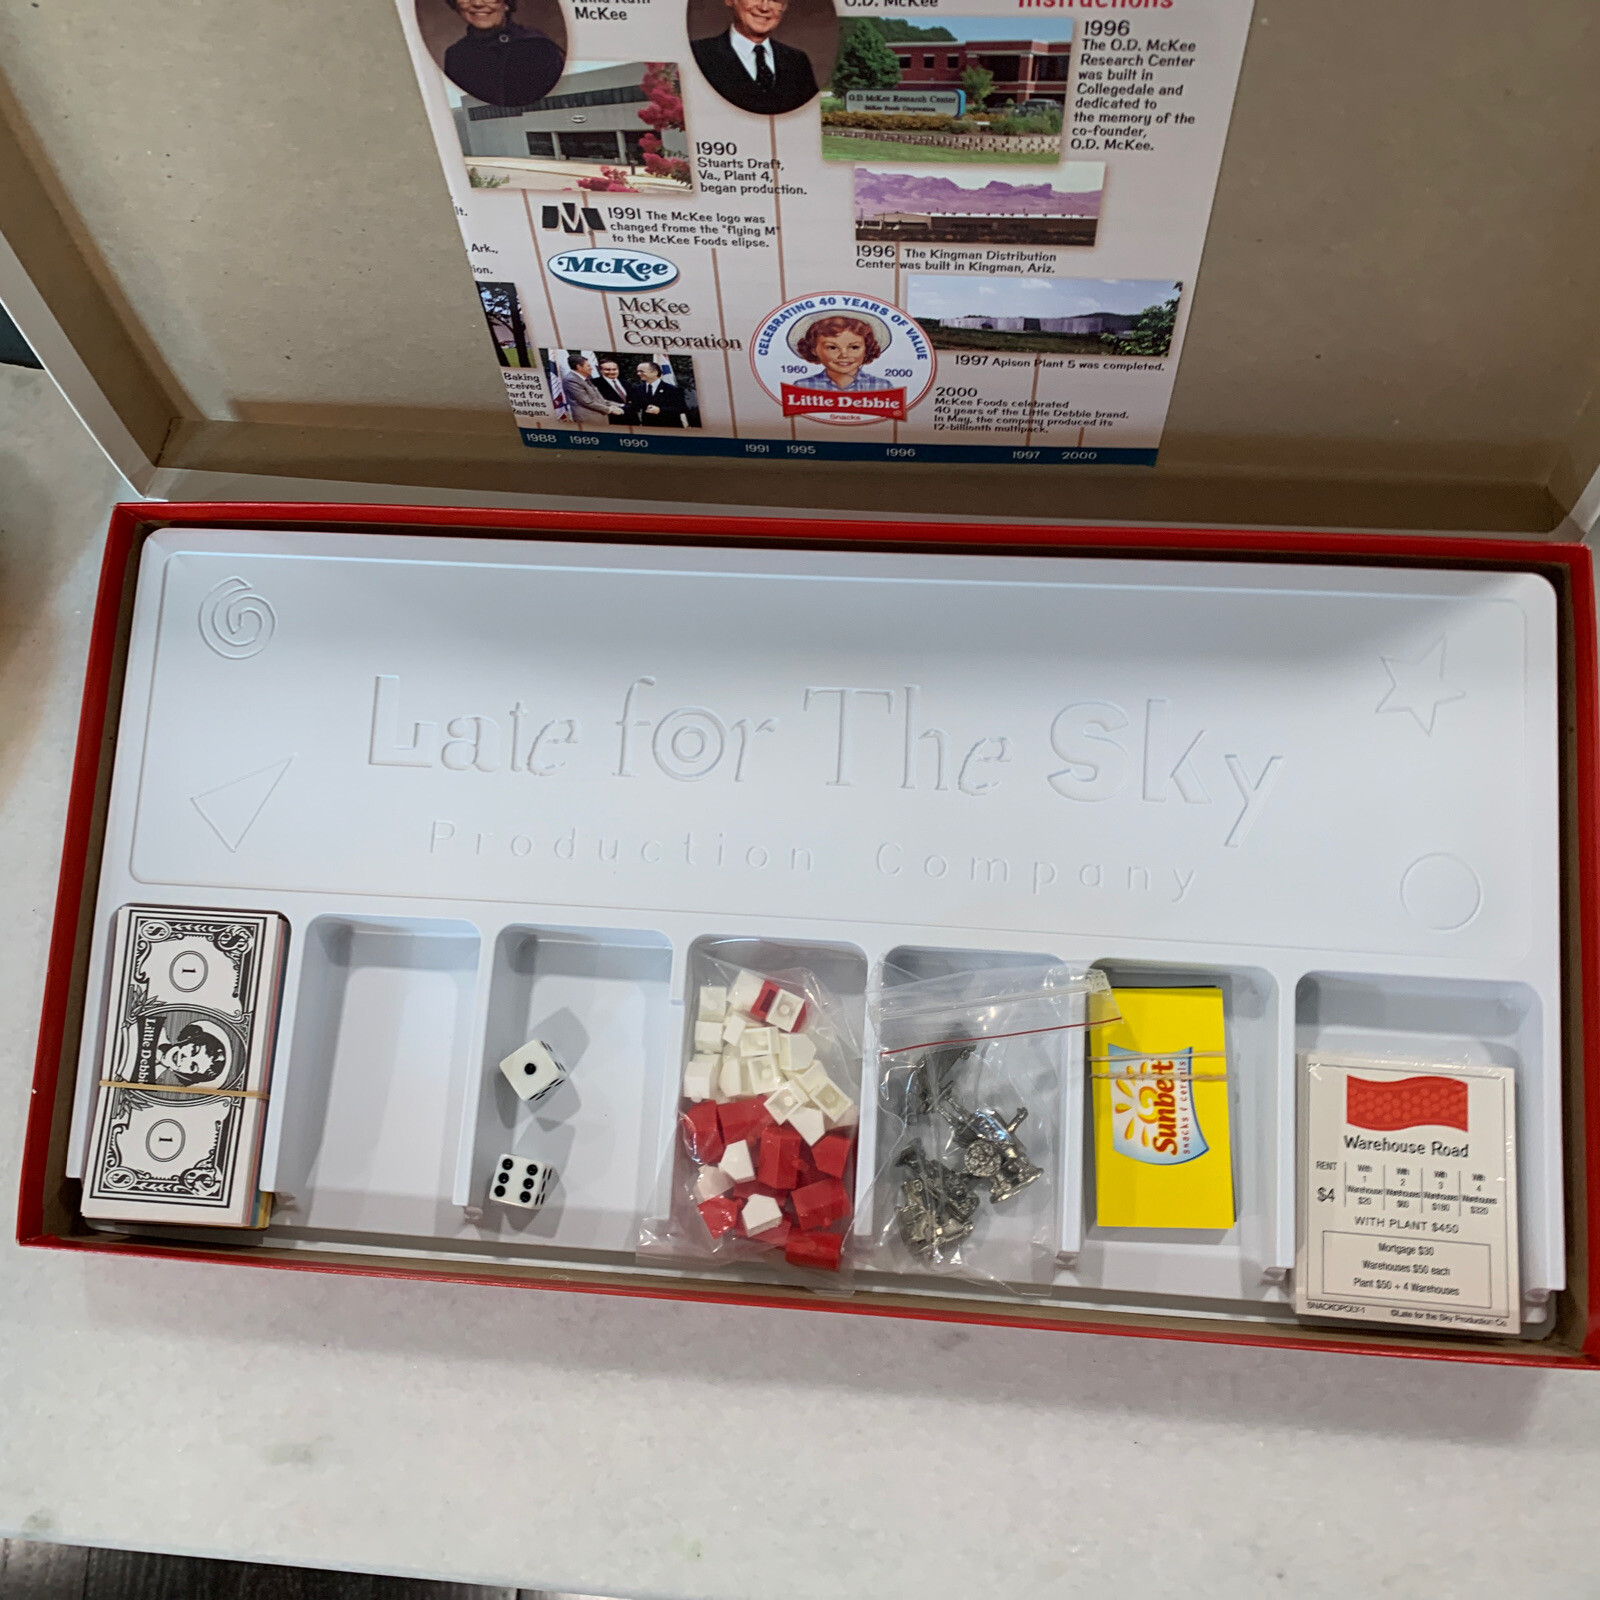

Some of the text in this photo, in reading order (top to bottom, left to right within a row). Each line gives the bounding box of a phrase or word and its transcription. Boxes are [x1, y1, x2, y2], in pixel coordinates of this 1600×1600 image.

[574, 6, 627, 20] McKee
[1084, 20, 1130, 36] 1996
[1082, 38, 1196, 52] The O.D. McKee
[1080, 53, 1196, 67] Research Center
[1078, 68, 1154, 81] was built in
[1077, 82, 1184, 98] Collegedale and
[1075, 97, 1157, 110] dedicated to
[1073, 111, 1195, 126] the memory of the
[1072, 125, 1147, 139] co-founder,
[696, 142, 737, 155] 1990
[1070, 138, 1154, 151] O.D. McKee.
[697, 157, 784, 171] Stuarts Draft,
[724, 170, 756, 181] Plant
[760, 171, 773, 183] 4,
[700, 182, 807, 196] began production.
[607, 206, 765, 224] 1991 The McKee logo was
[610, 222, 658, 234] changed
[661, 223, 697, 233] frome
[700, 224, 719, 234] the
[722, 225, 761, 237] "flying
[612, 234, 769, 249] to the McKee Foods elipse.
[856, 245, 1057, 262] 1996 The Kingman Distribution
[557, 256, 668, 282] McKee
[856, 259, 1055, 274] Center was built in Kingman, Ariz.
[617, 297, 690, 314] McKee
[621, 314, 680, 331] Foods
[757, 297, 928, 361] CELEBRATING 40 YEARS OF VALUE
[624, 331, 742, 350] Corporation
[780, 365, 808, 374] 1960
[955, 354, 988, 366] 1997
[992, 357, 1030, 368] Apison
[1034, 358, 1064, 369] Plant
[1079, 361, 1100, 370] was
[1103, 361, 1165, 372] completed.
[504, 372, 540, 383] Baking
[884, 368, 913, 378] 2000
[528, 391, 544, 399] for
[936, 387, 978, 397] 2000
[787, 394, 900, 409] Little Debbie
[934, 398, 1069, 409] McKee Foods celebrated
[829, 413, 861, 421] Snacks
[934, 406, 1129, 419] 40 years of the Little Debbie brand.
[947, 415, 972, 424] May,
[976, 416, 993, 424] the
[996, 417, 1044, 426] company
[1047, 419, 1097, 427] produced
[1099, 419, 1113, 427] its
[933, 423, 1048, 434] 12-billionth multipack.
[526, 433, 557, 443] 1988
[569, 435, 600, 445] 1989
[619, 438, 649, 448] 1990
[745, 443, 769, 453] 1991
[786, 444, 816, 454] 1995
[886, 447, 915, 457] 1996
[1012, 450, 1040, 460] 1997
[1062, 451, 1097, 460] 2000
[368, 674, 1285, 848] Late for The Sky
[428, 820, 1198, 904] Production Company
[137, 1018, 156, 1085] Little Debbi
[1151, 1060, 1178, 1156] Sunbet
[1180, 1117, 1191, 1155] snacks
[1344, 1135, 1470, 1158] Warehouse Road
[1316, 1161, 1337, 1171] RENT
[1400, 1178, 1406, 1186] 2
[1317, 1187, 1336, 1203] $4
[1354, 1216, 1460, 1234] WITH PLANT $450
[1378, 1242, 1434, 1256] Mortgage $30
[1362, 1259, 1451, 1276] Warehouses $50 each
[1353, 1277, 1460, 1296] Plant $50 4 Warehouses
